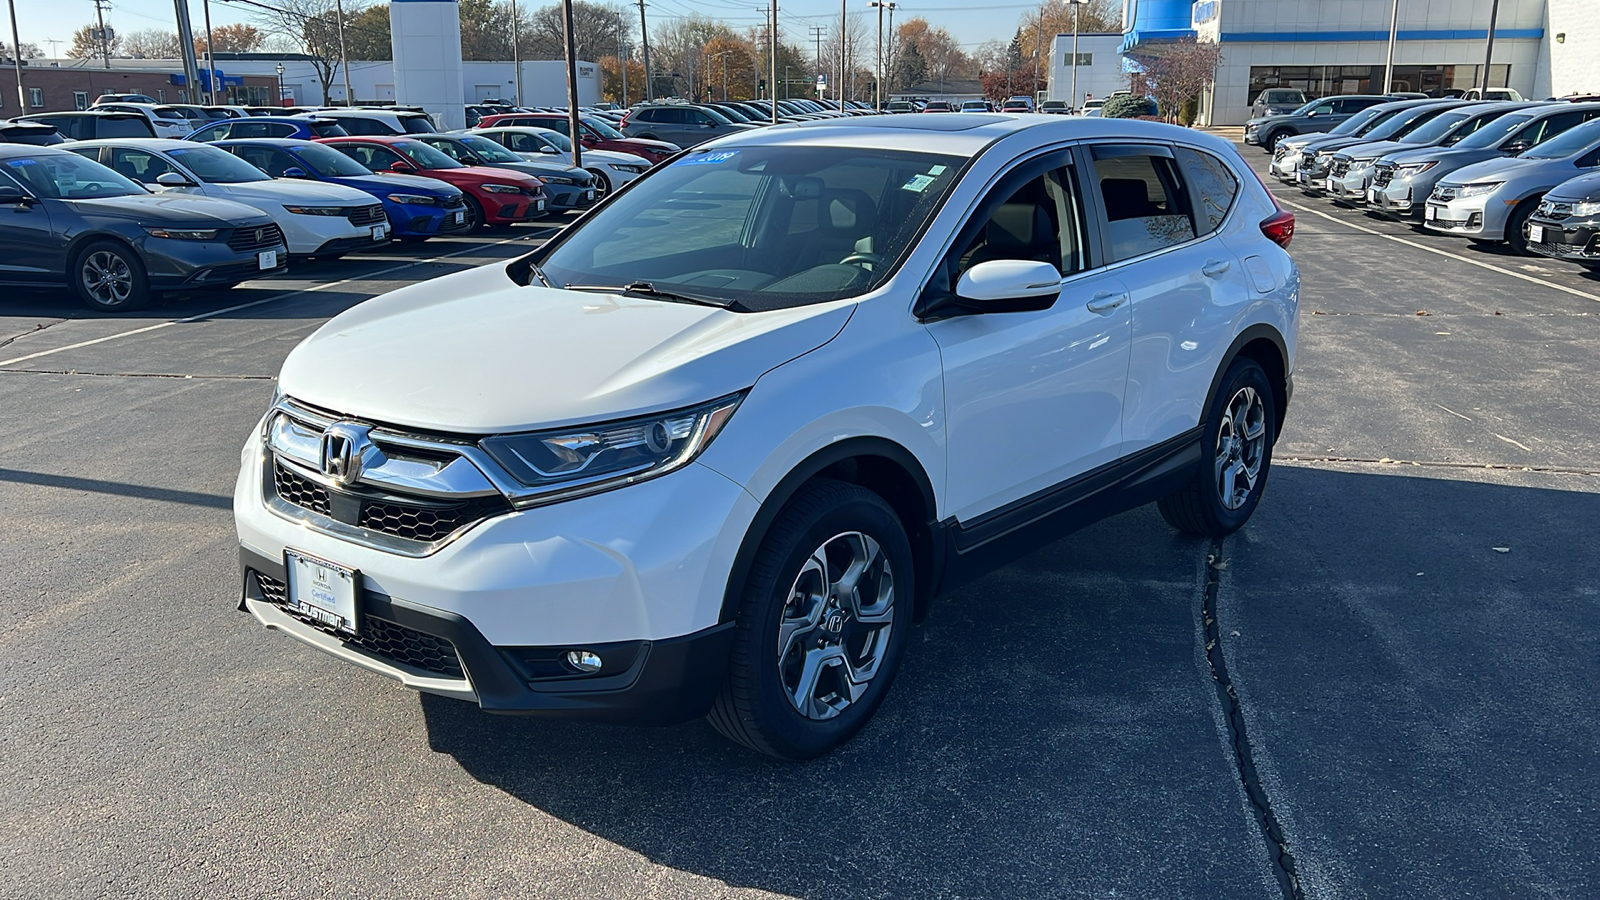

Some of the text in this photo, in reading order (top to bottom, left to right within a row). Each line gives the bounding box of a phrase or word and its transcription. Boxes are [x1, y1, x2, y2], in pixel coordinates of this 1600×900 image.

[698, 151, 736, 163] 2019
[313, 579, 332, 591] HONDA
[312, 589, 336, 604] Certified
[300, 602, 342, 628] GUSTMAN
